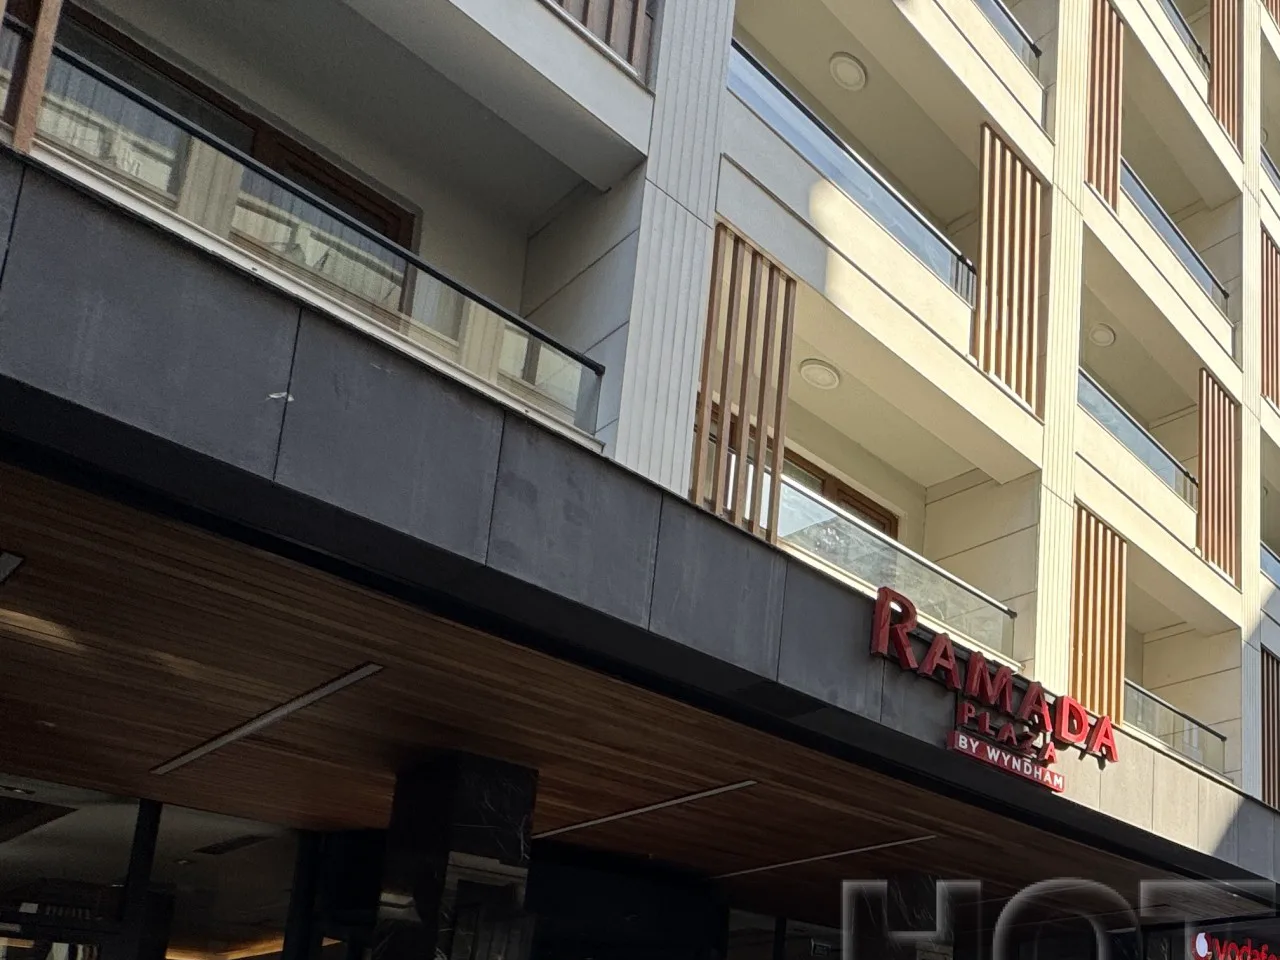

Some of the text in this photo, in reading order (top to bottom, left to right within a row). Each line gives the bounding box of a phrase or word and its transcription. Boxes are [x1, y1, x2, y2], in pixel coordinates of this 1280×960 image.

[871, 586, 1119, 762] RAMADA
[956, 701, 1058, 764] PLAZA
[958, 733, 1065, 789] BY WYNDHAM
